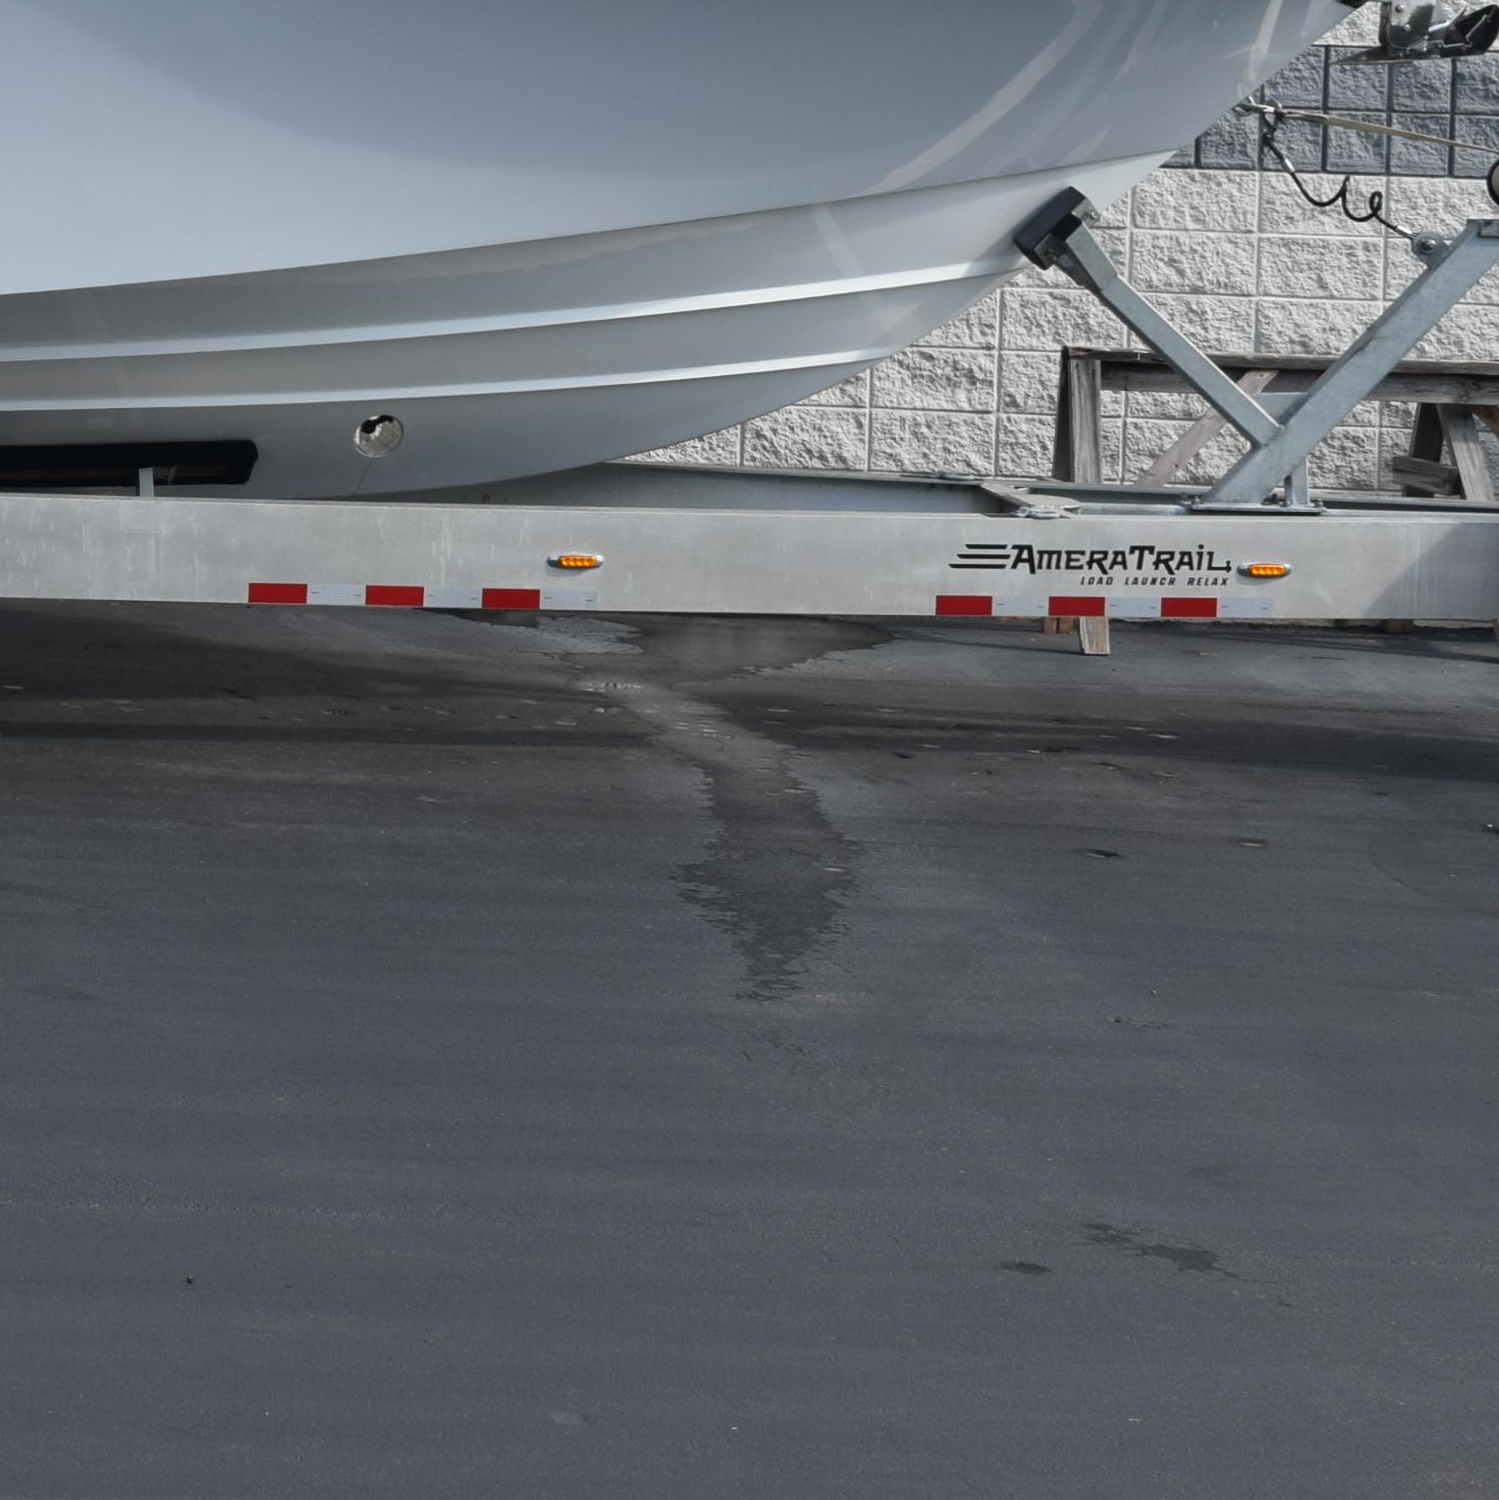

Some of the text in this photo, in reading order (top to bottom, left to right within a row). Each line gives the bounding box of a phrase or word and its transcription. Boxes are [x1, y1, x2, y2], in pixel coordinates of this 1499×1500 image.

[1080, 576, 1229, 587] LOAD LAUNCH RELAX
